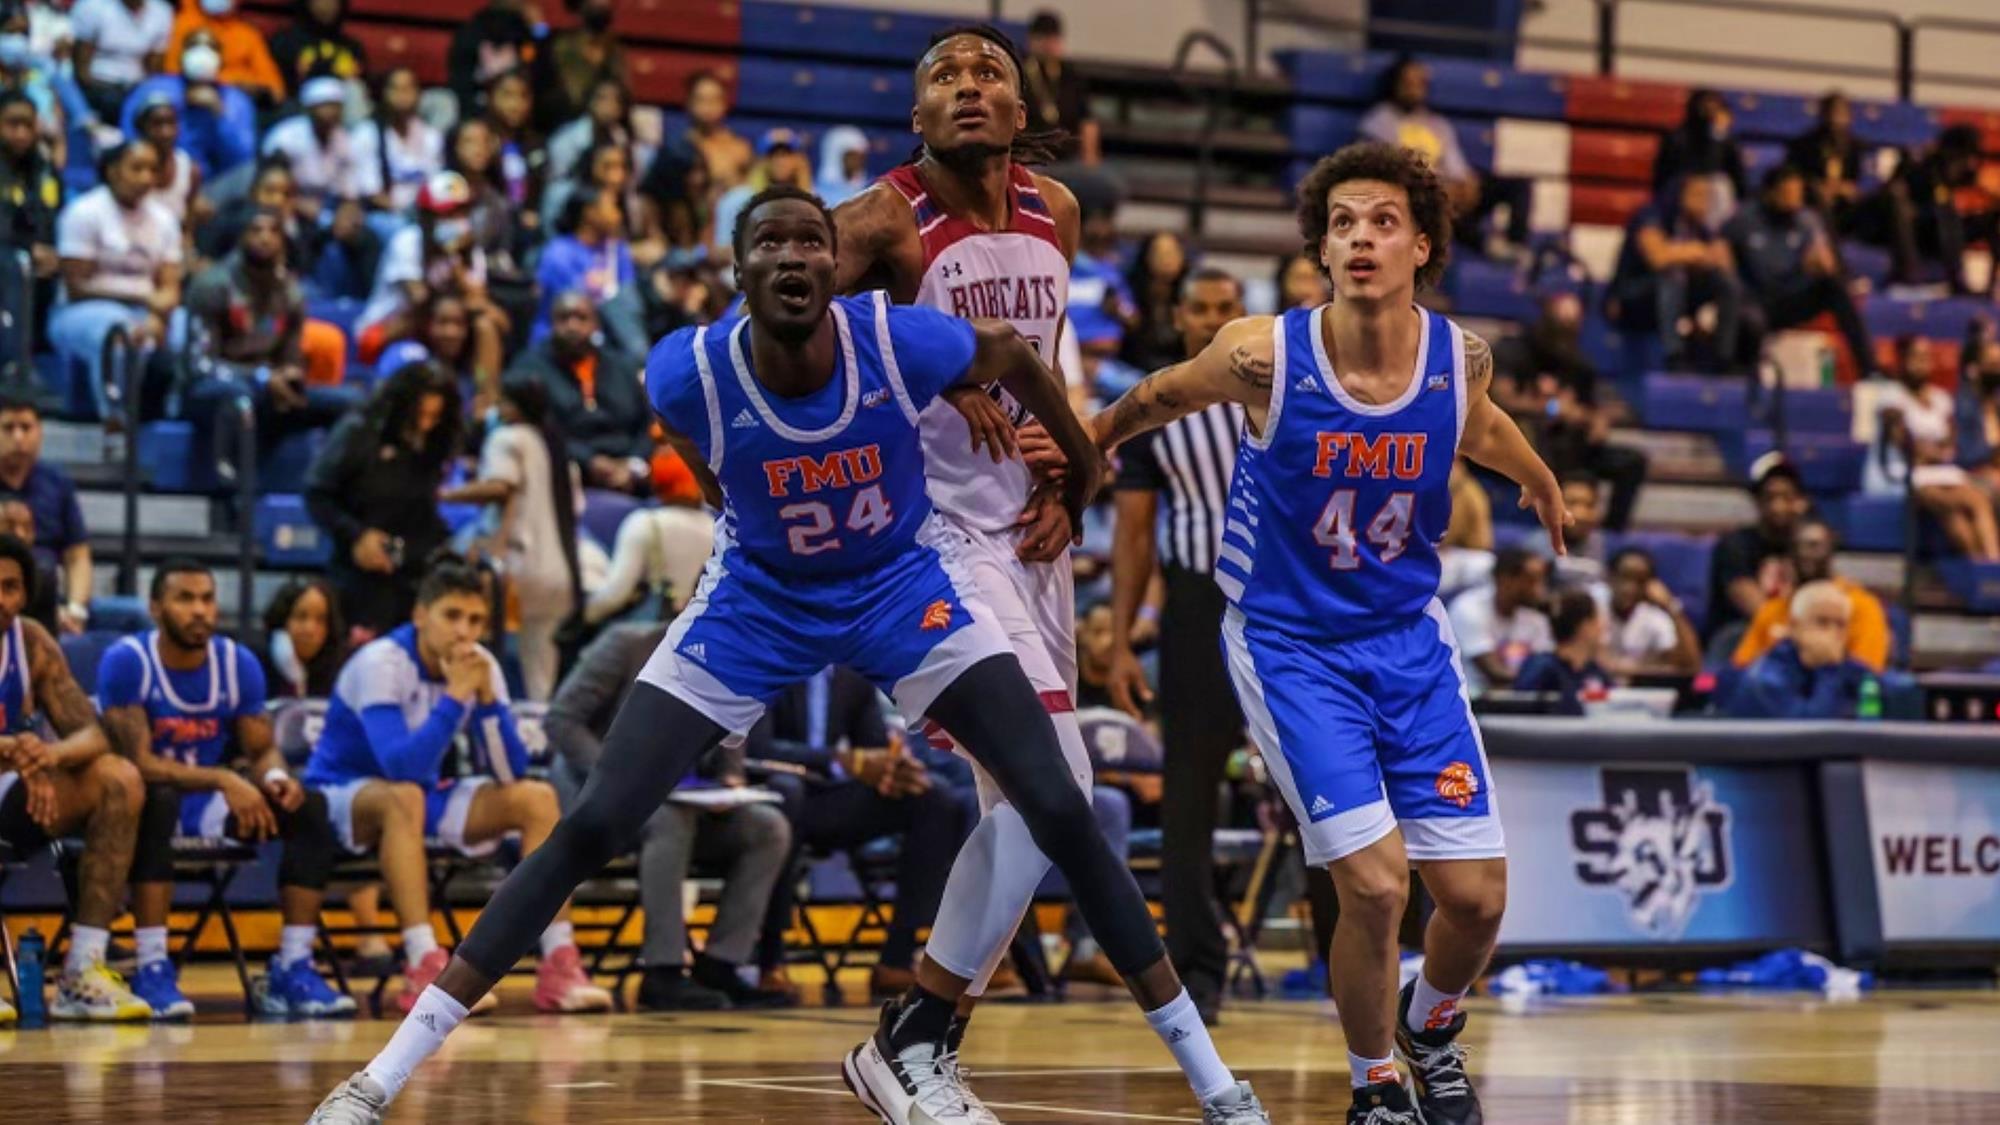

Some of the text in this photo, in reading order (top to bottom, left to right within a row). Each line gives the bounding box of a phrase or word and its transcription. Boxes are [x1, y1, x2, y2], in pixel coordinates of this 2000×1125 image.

[949, 276, 1058, 319] BOBCATS
[763, 442, 883, 497] FMU
[1313, 431, 1428, 480] FMU
[779, 484, 894, 555] 24
[1312, 489, 1416, 570] 44
[1882, 834, 2000, 876] WELC
